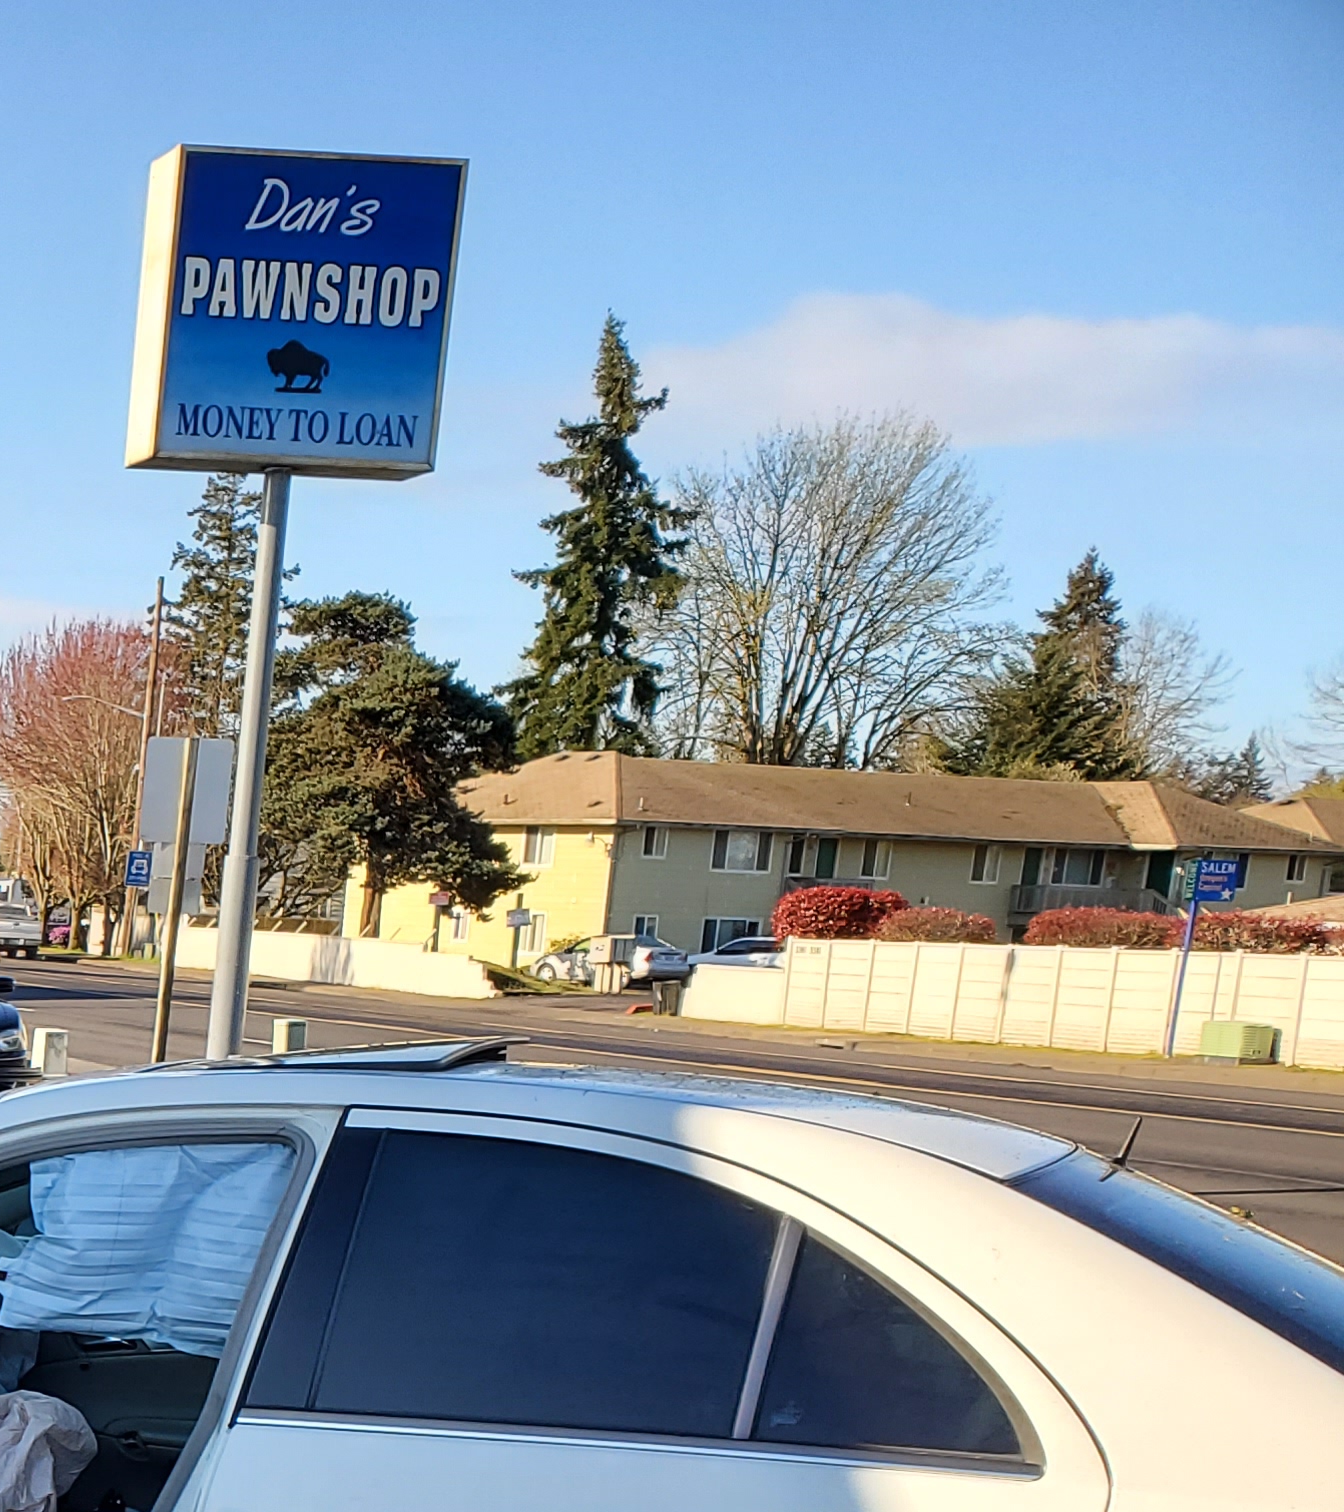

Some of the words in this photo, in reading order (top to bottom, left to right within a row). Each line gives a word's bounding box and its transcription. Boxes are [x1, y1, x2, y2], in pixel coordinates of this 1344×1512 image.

[245, 178, 381, 235] Dan's
[180, 256, 440, 328] PAWNSHOP
[175, 403, 285, 441] MONEY
[288, 409, 330, 443] TO
[336, 412, 420, 448] LOAN
[1201, 861, 1237, 873] SALEM
